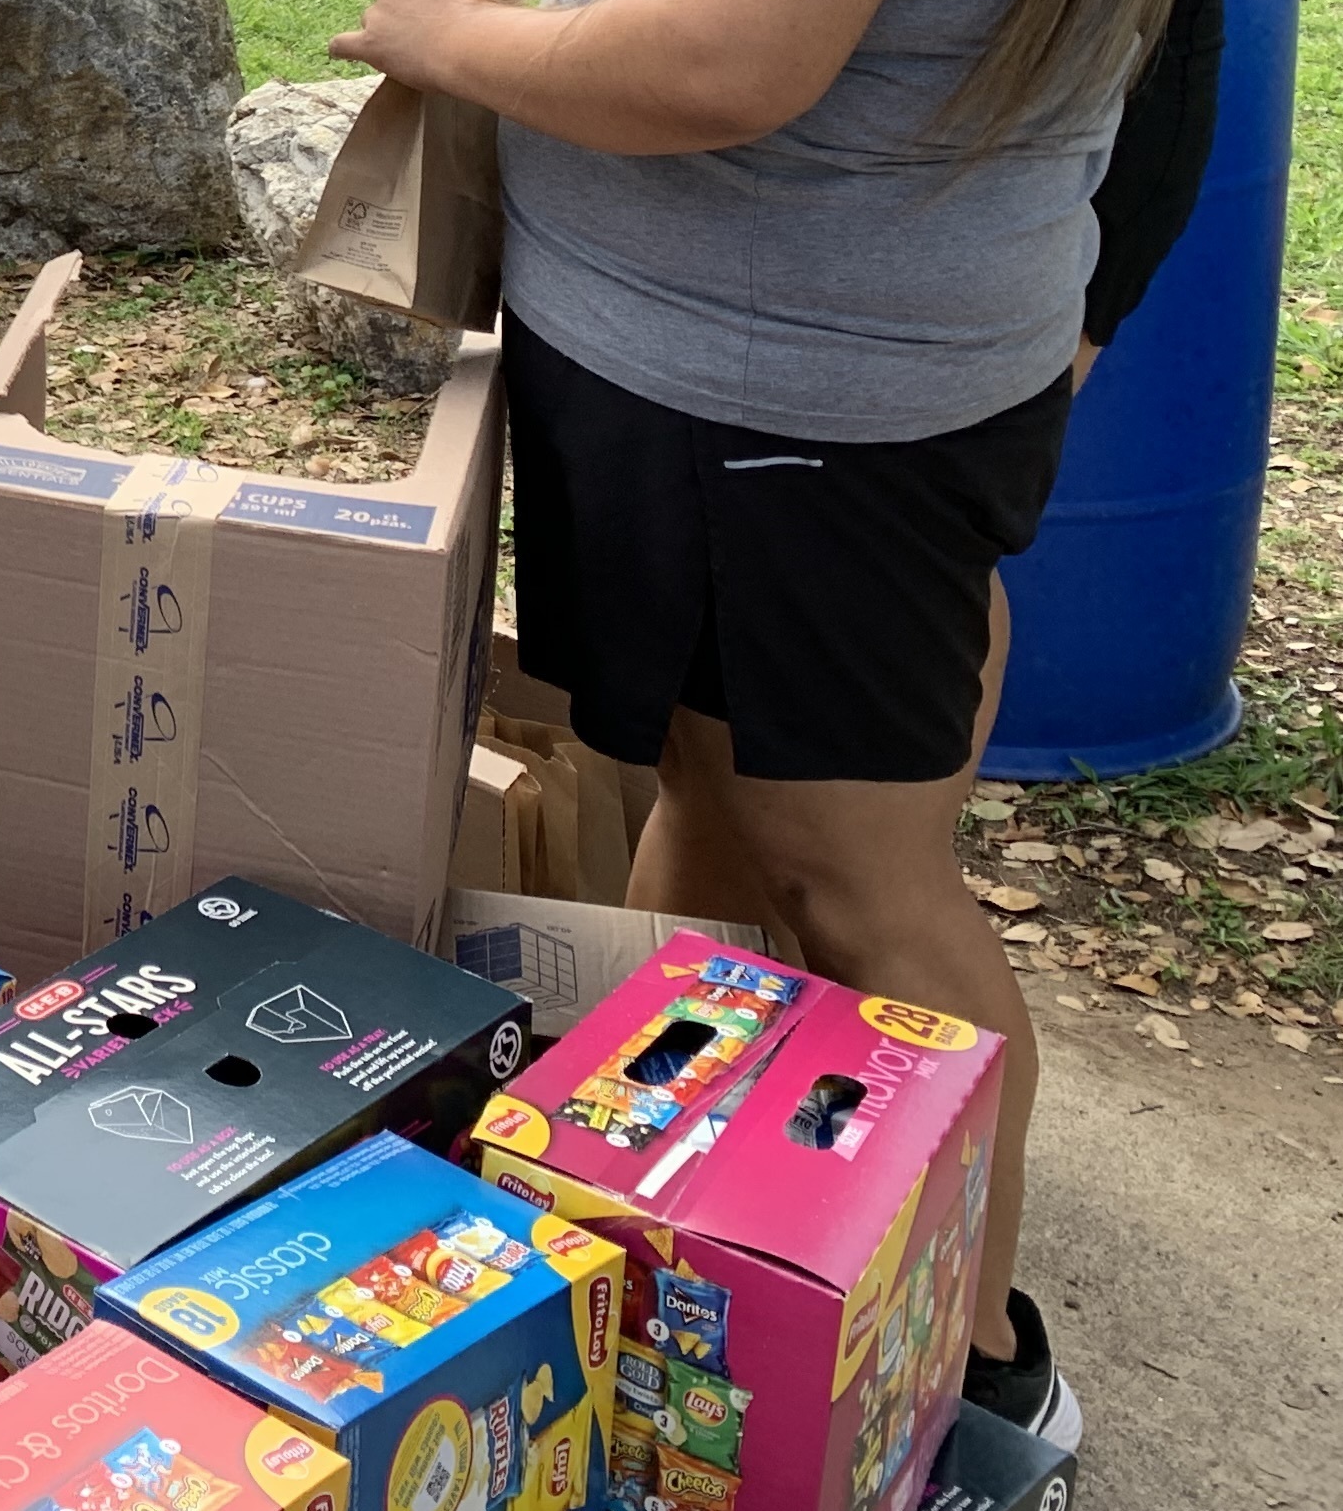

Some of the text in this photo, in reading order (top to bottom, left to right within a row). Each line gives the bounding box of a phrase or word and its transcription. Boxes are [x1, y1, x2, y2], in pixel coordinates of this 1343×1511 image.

[240, 502, 270, 514] 591
[247, 492, 307, 510] CUPS
[334, 508, 371, 523] 20
[23, 985, 76, 1015] H-E-B
[874, 1002, 941, 1040] 28
[935, 1021, 962, 1047] BAGS
[914, 1056, 941, 1079] MIX
[501, 1176, 551, 1210] FritoLay
[199, 1266, 230, 1286] MIX
[214, 1232, 332, 1300] classic
[169, 1301, 227, 1337] 18
[589, 1282, 609, 1363] FritoLay
[666, 1294, 718, 1323] Doritos
[653, 1322, 662, 1336] 3
[619, 1363, 661, 1391] GOLD
[625, 1355, 661, 1378] ROLD
[51, 1355, 181, 1440] Doritos
[685, 1393, 726, 1419] Lay's
[659, 1414, 668, 1427] 3
[17, 1431, 62, 1460] &
[262, 1439, 314, 1472] FritoLay
[489, 1396, 511, 1499] RUFFLES
[667, 1471, 726, 1499] Cheetos
